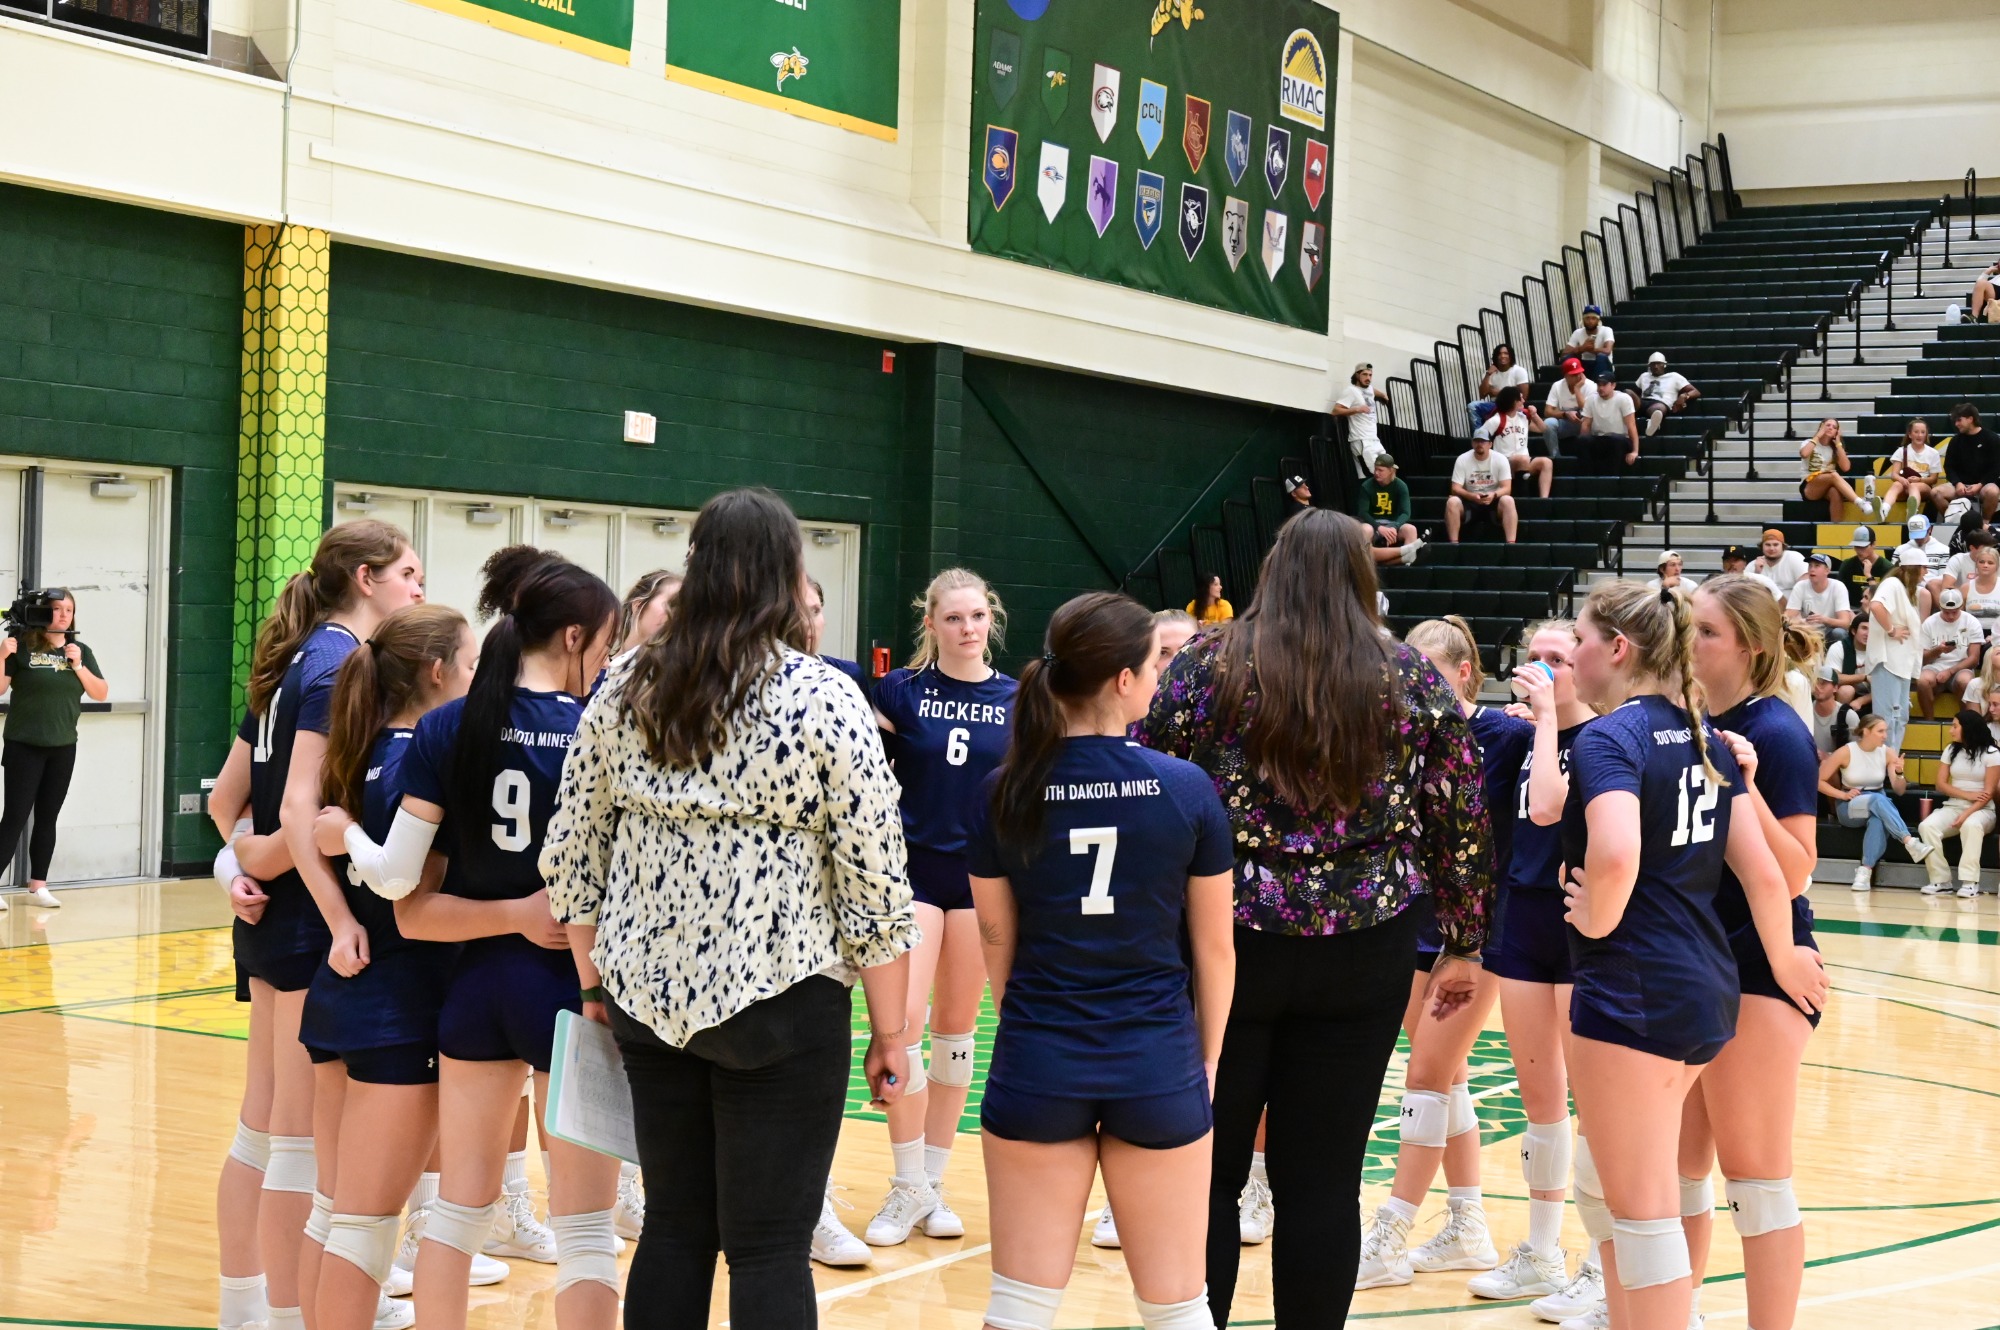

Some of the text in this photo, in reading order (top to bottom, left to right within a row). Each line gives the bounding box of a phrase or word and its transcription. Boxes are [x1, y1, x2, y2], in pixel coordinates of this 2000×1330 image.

[1282, 75, 1324, 115] RMAC
[1141, 102, 1162, 124] CCU
[634, 414, 653, 440] EXIT
[918, 699, 1006, 725] ROCKERS
[537, 731, 573, 749] MINES
[946, 727, 971, 766] 6
[1069, 782, 1118, 800] DAKOTA
[1121, 778, 1161, 797] MINES
[491, 768, 532, 853] 9
[1670, 764, 1719, 847] 12
[1069, 826, 1118, 916] 7
